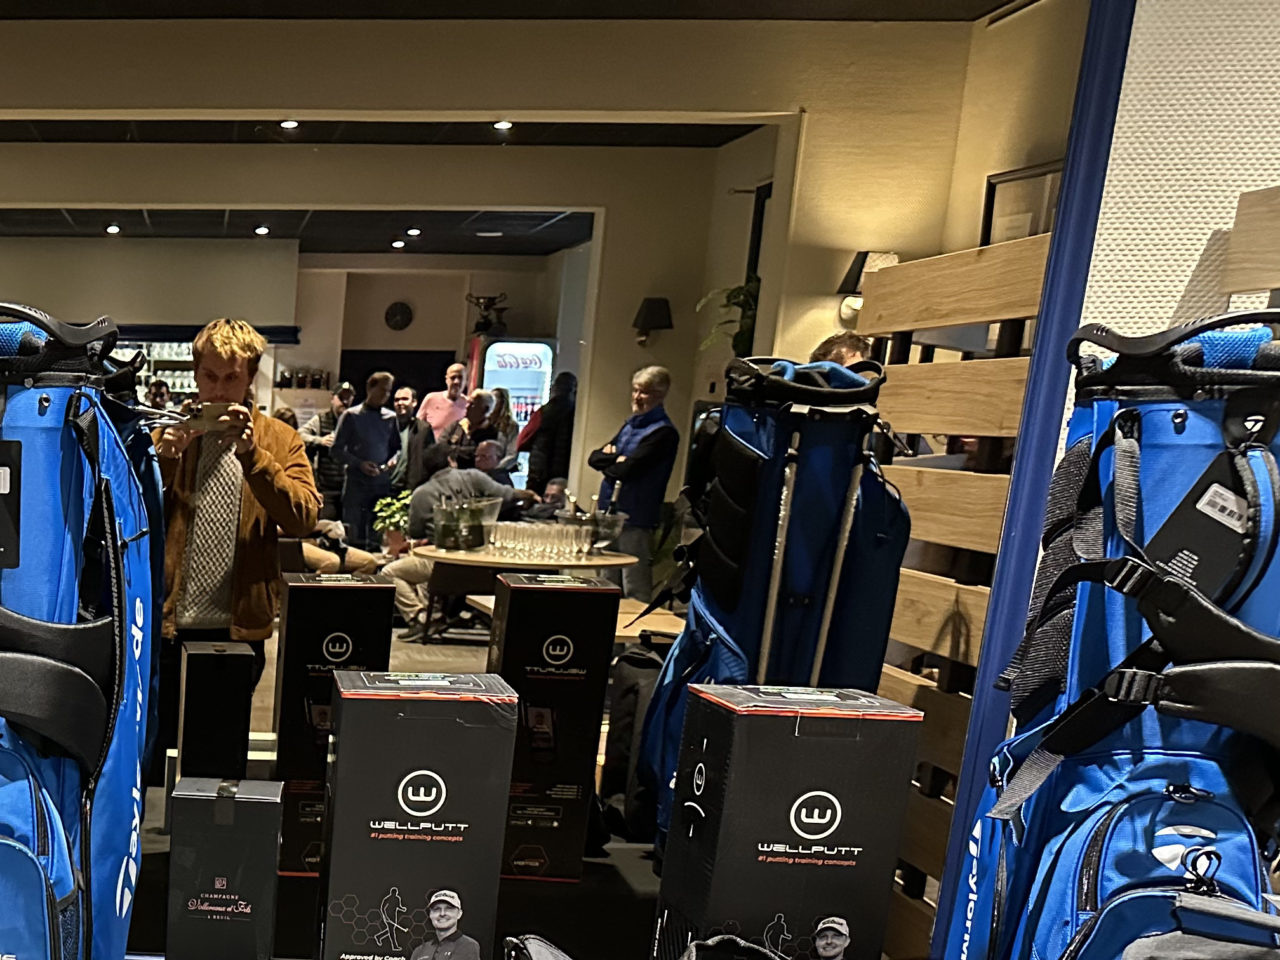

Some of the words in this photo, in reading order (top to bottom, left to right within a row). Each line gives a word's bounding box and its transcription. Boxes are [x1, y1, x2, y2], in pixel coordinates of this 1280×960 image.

[370, 820, 469, 831] WELLPUTT
[758, 843, 863, 855] WELLPUTT
[767, 856, 793, 864] putting
[340, 953, 374, 960] Approved
